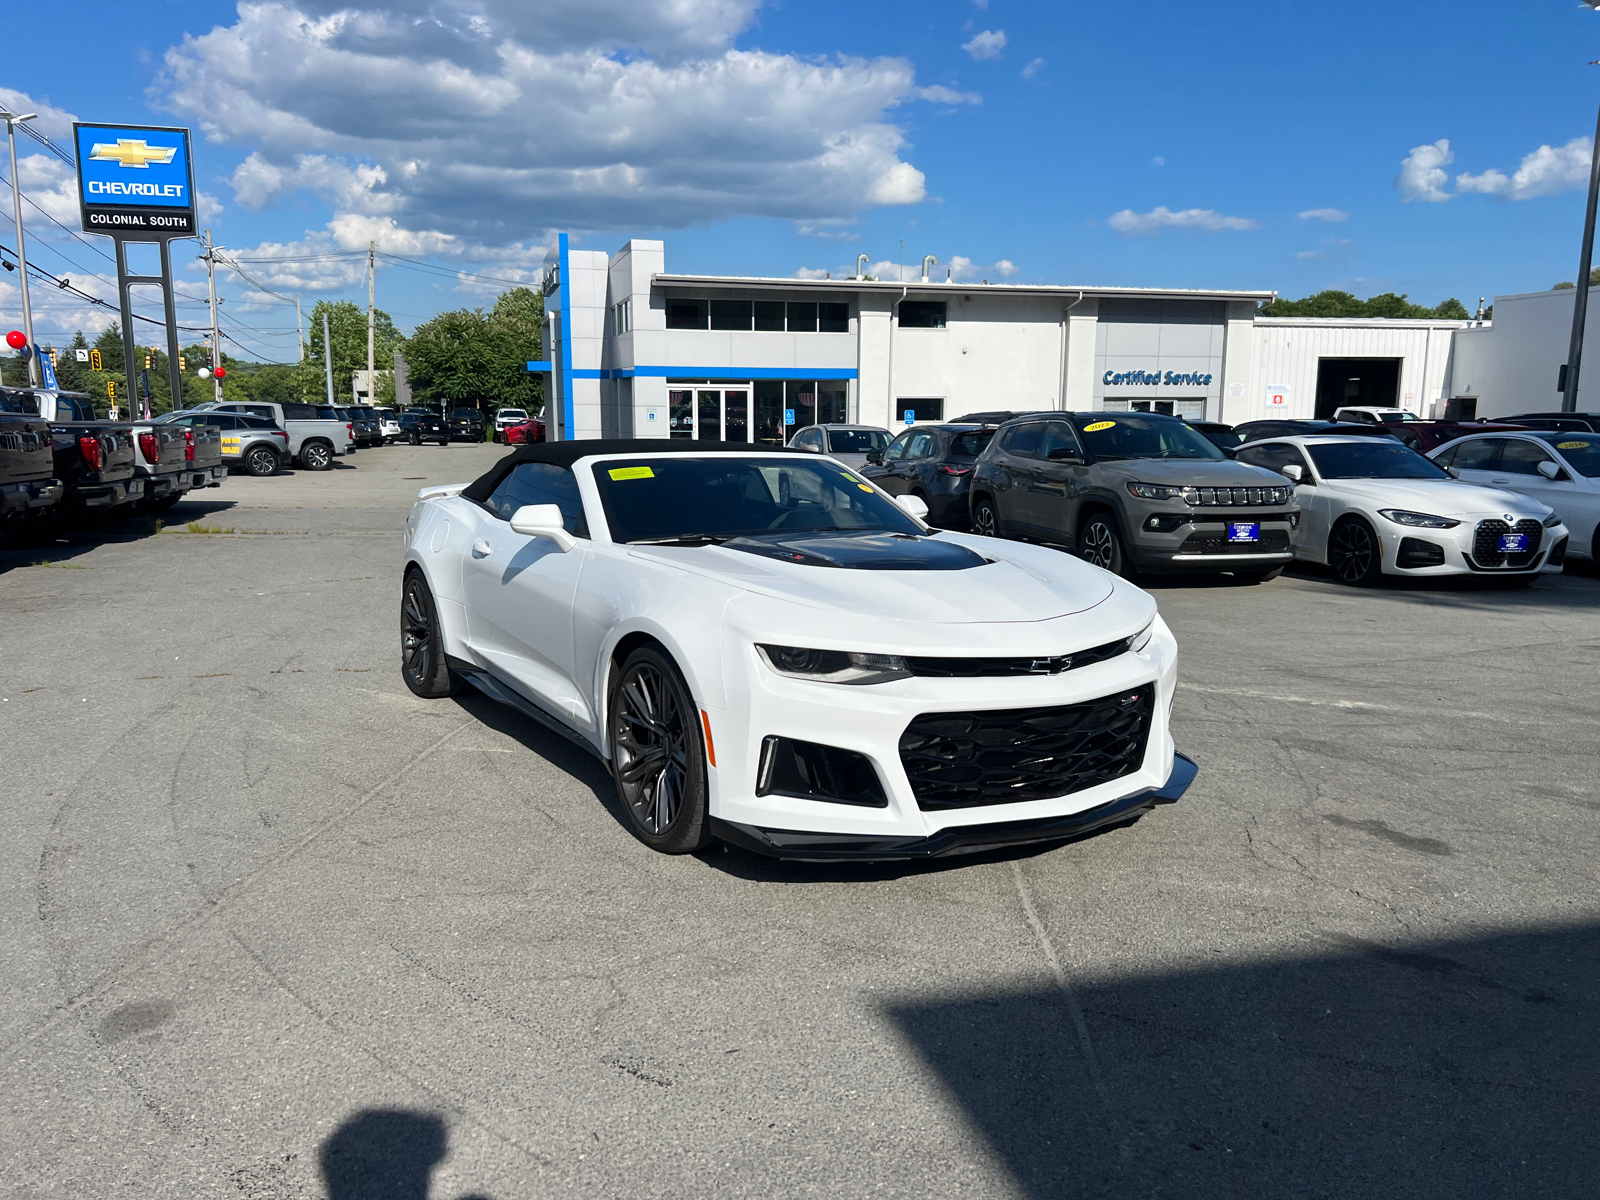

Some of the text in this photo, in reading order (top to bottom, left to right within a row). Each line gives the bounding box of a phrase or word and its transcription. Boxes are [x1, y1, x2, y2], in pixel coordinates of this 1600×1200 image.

[88, 181, 184, 197] CHEVROLET
[90, 213, 188, 227] COLONIAL SOUTH
[1103, 370, 1213, 386] Certified Service
